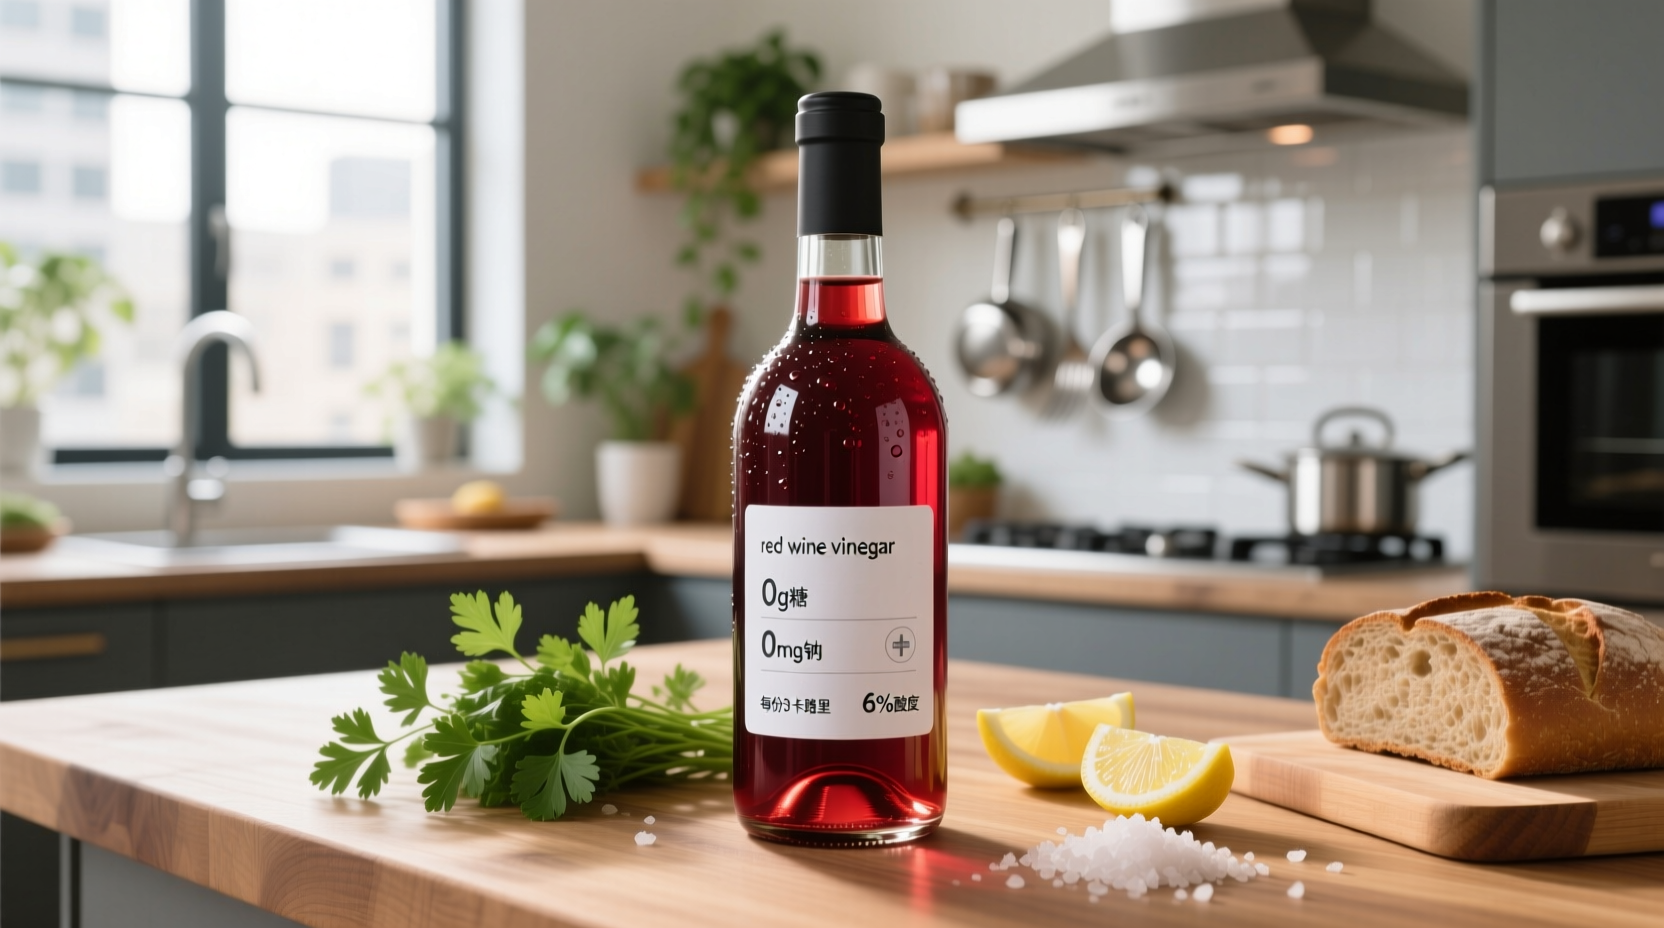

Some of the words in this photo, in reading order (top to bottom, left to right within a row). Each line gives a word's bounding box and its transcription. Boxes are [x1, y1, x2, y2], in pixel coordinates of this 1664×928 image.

[761, 536, 783, 554] red
[788, 537, 827, 555] wine
[831, 537, 895, 560] vinegar
[762, 578, 808, 612] 0g糖
[762, 630, 822, 664] 0mg钠
